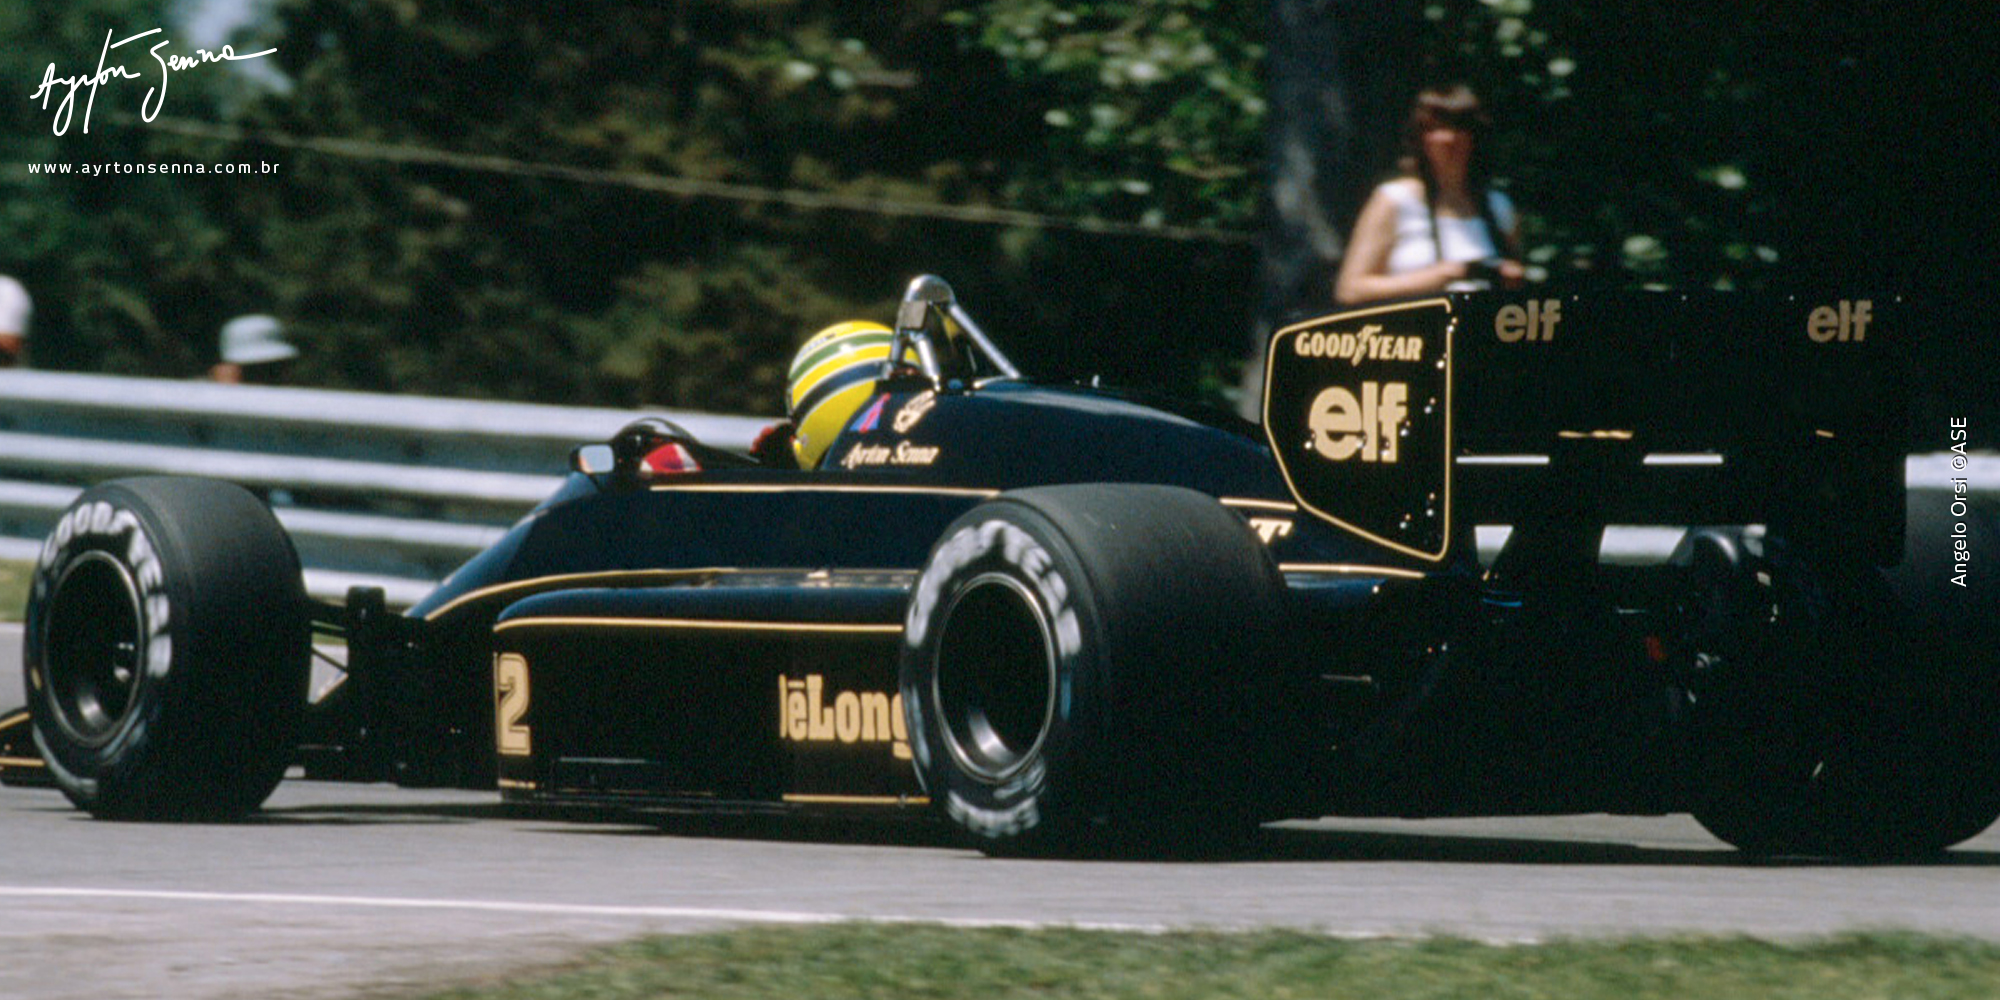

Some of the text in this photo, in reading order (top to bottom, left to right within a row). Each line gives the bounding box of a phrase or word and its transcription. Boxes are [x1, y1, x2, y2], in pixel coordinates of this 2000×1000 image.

[1494, 299, 1562, 343] elf
[1807, 299, 1873, 343] elf
[1294, 324, 1424, 367] GOODYEAR
[1308, 381, 1408, 463] elf
